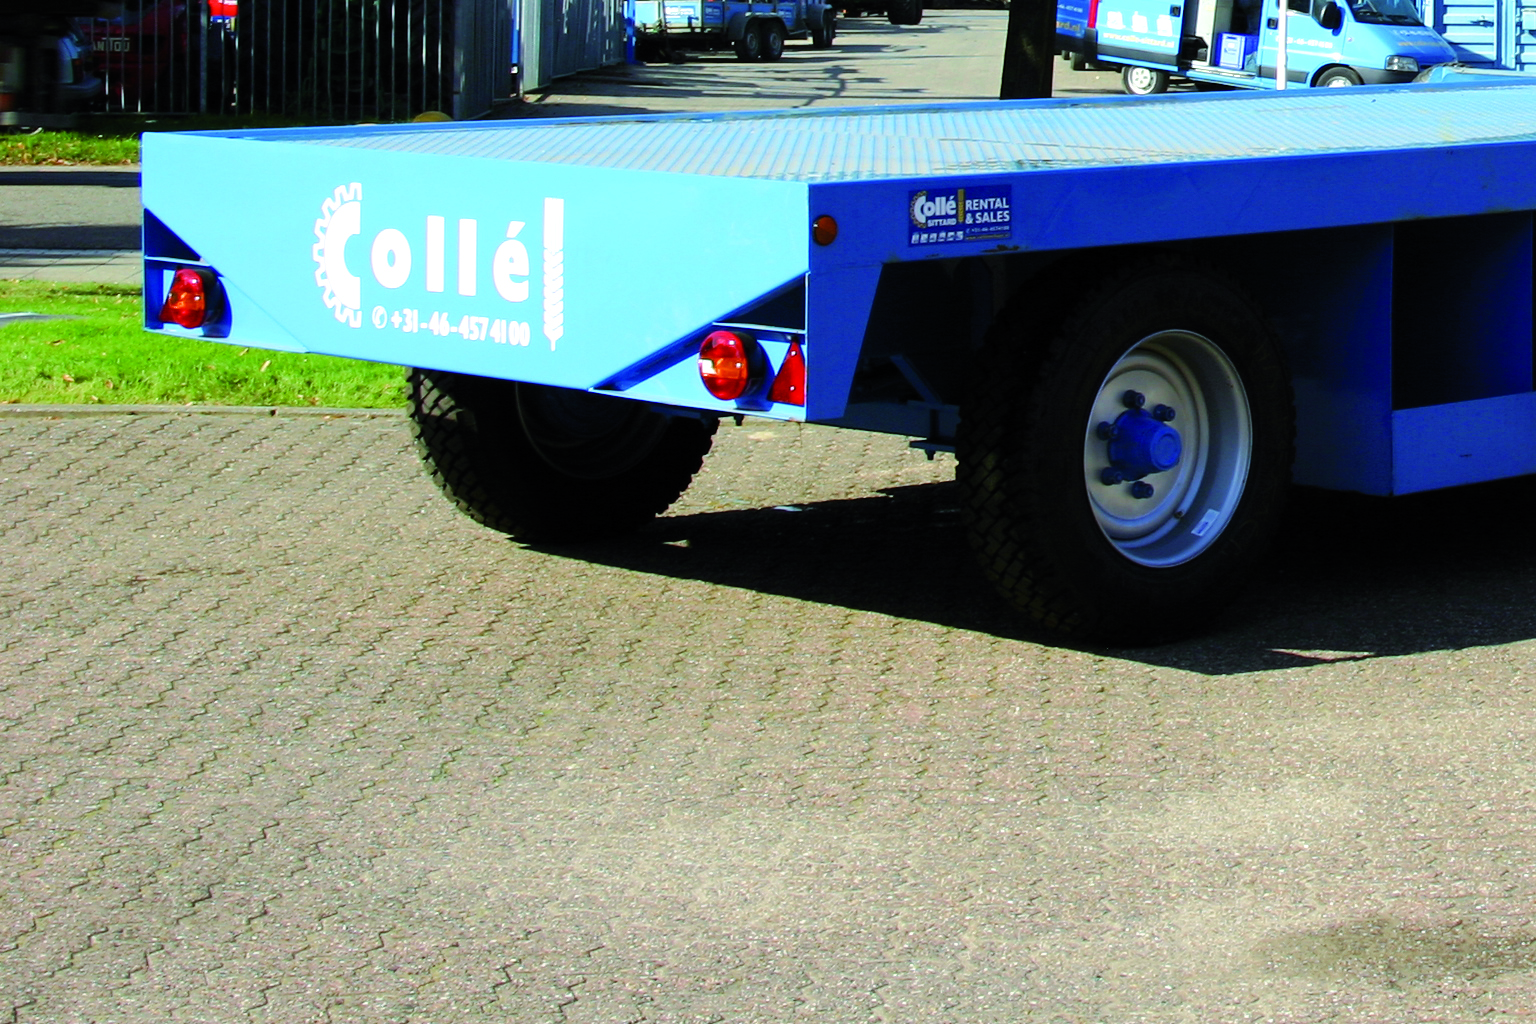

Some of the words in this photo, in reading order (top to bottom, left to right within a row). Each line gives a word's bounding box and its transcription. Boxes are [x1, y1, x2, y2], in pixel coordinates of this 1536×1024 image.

[914, 195, 957, 223] Collé
[965, 197, 1009, 211] RENTAL
[965, 213, 973, 224] &
[975, 210, 1010, 223] SALES
[324, 200, 530, 310] Collé
